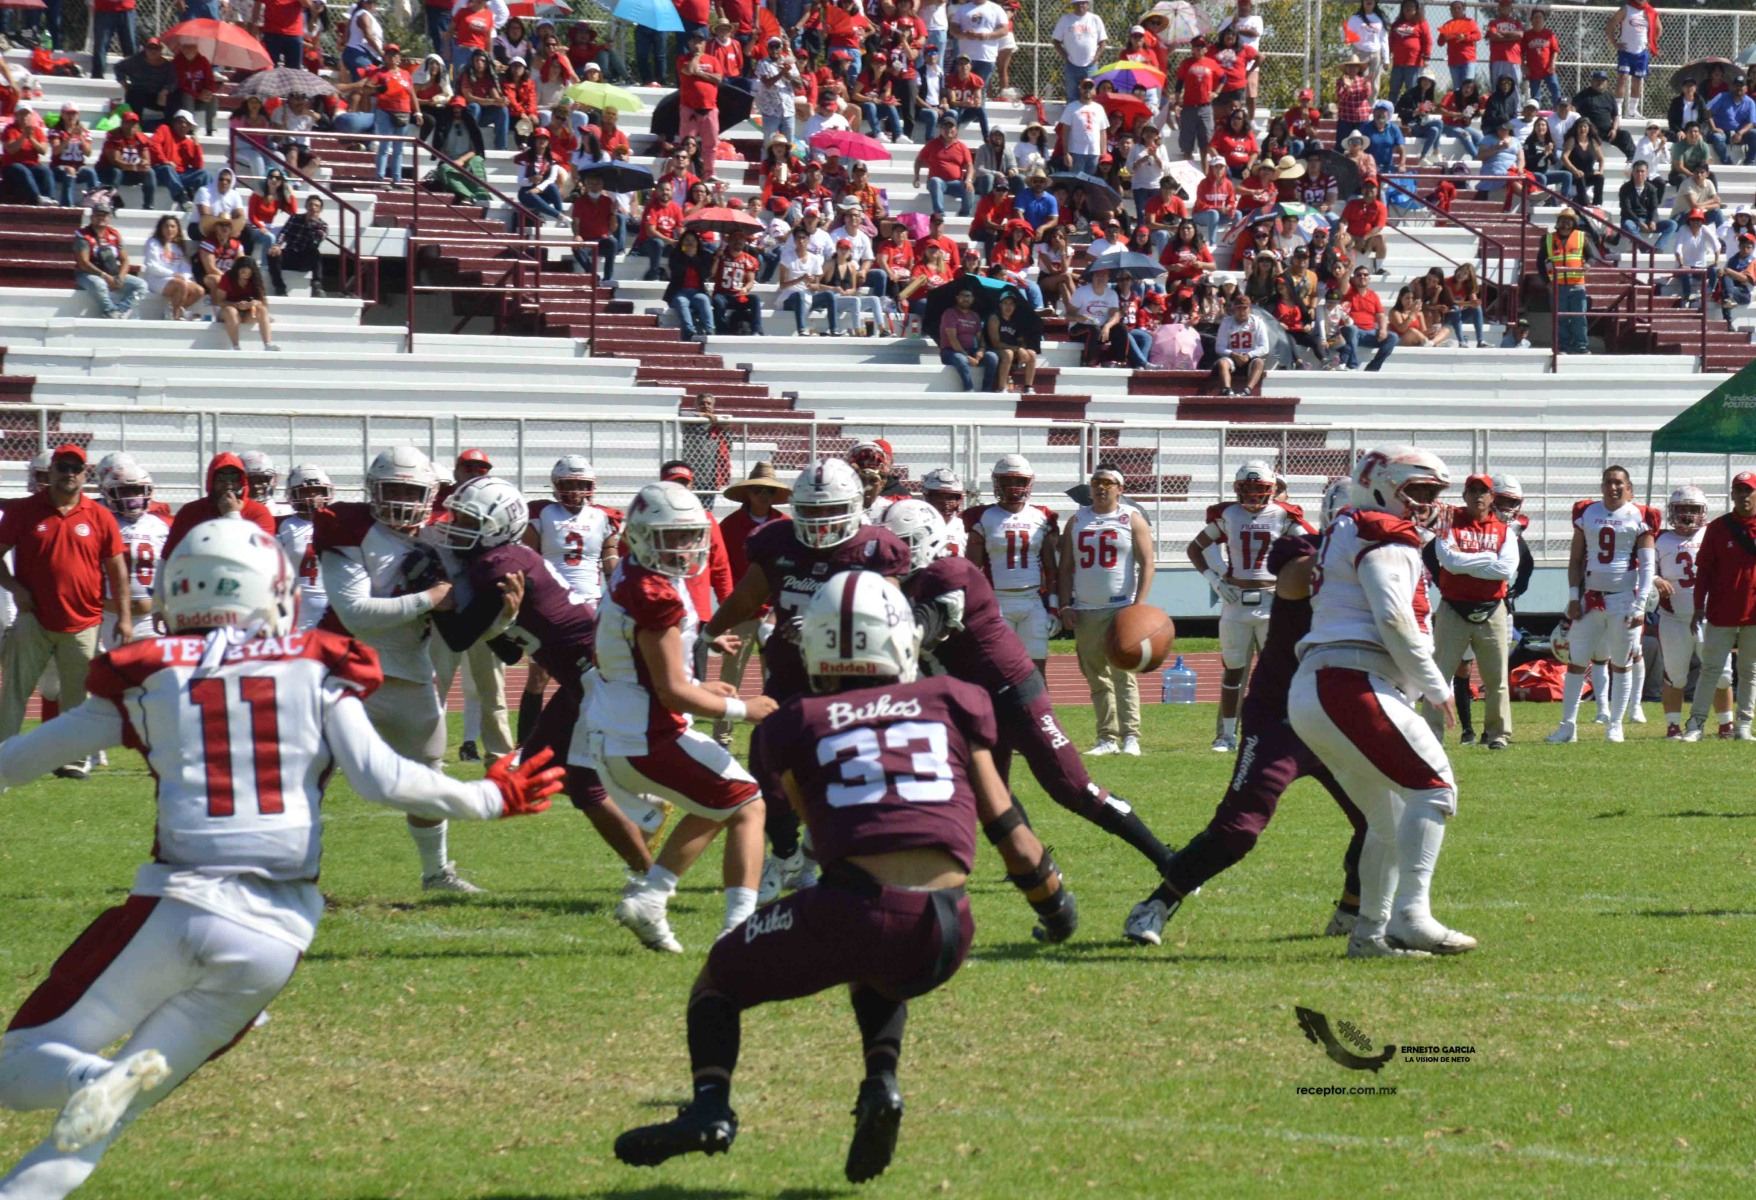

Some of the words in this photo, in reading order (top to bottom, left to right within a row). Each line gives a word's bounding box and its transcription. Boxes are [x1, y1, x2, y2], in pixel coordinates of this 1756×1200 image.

[563, 532, 583, 567] 3
[1005, 530, 1030, 570] 11
[1078, 530, 1117, 568] 56
[1239, 531, 1272, 570] 17
[1597, 527, 1616, 564] 9
[175, 611, 239, 628] Riddell
[155, 635, 304, 663] TEEYAC
[826, 630, 837, 649] 3
[855, 631, 867, 650] 3
[819, 661, 877, 676] Riddell
[826, 694, 922, 730] Bukos
[190, 677, 285, 817] 11
[816, 721, 956, 809] 33
[744, 902, 793, 944] Bukos
